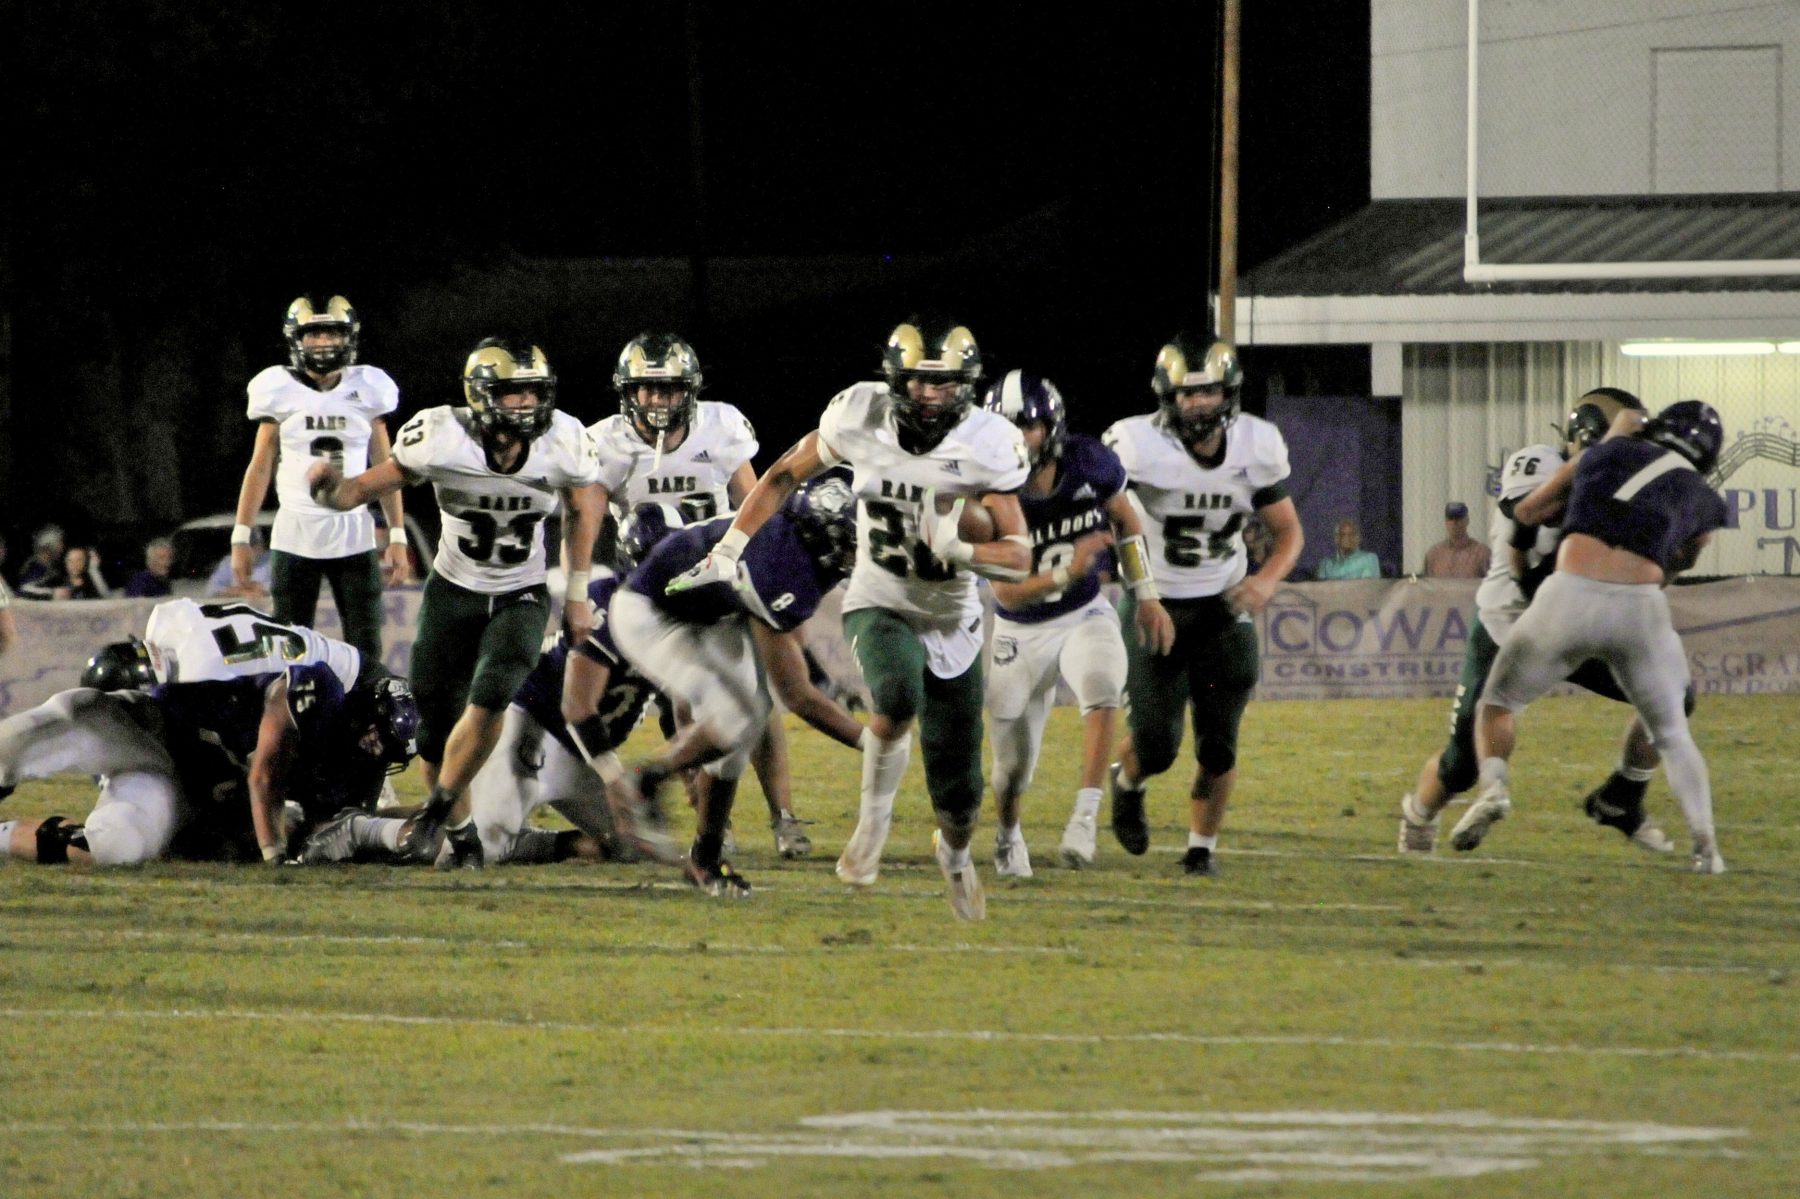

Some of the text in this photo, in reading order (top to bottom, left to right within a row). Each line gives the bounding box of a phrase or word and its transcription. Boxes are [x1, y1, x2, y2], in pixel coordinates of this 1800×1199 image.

[305, 415, 347, 431] RAMS
[402, 418, 424, 447] 33
[1511, 455, 1542, 476] 56
[647, 475, 697, 494] RAMS
[881, 479, 925, 503] RAM
[479, 495, 533, 511] RAMS
[1184, 493, 1233, 509] RAMS
[456, 510, 547, 564] 33
[1033, 508, 1103, 545] LLDOGS
[1163, 511, 1244, 569] 54
[771, 592, 796, 612] 8
[1269, 606, 1468, 654] COWA
[295, 679, 317, 713] 15
